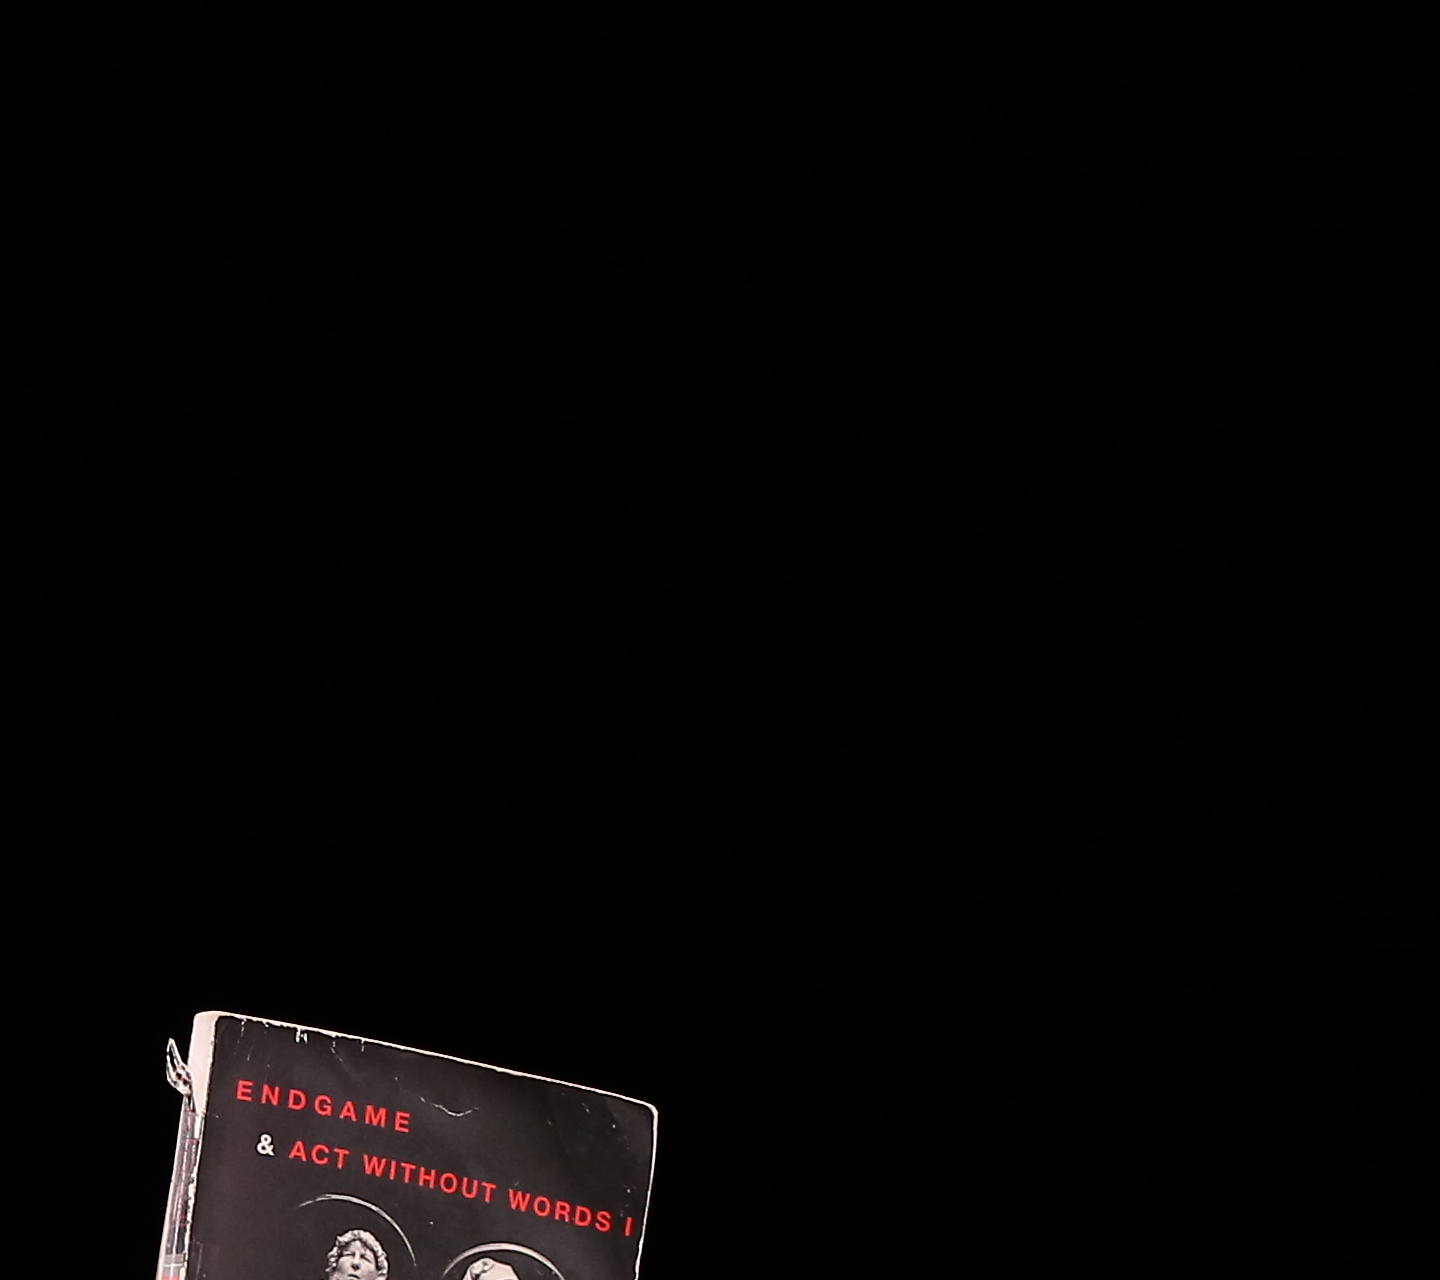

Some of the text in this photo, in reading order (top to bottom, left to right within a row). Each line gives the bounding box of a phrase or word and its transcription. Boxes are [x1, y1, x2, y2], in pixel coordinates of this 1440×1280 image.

[236, 1079, 413, 1134] ENDGAME
[256, 1134, 634, 1238] & ACT WITHOUT WORDS I
